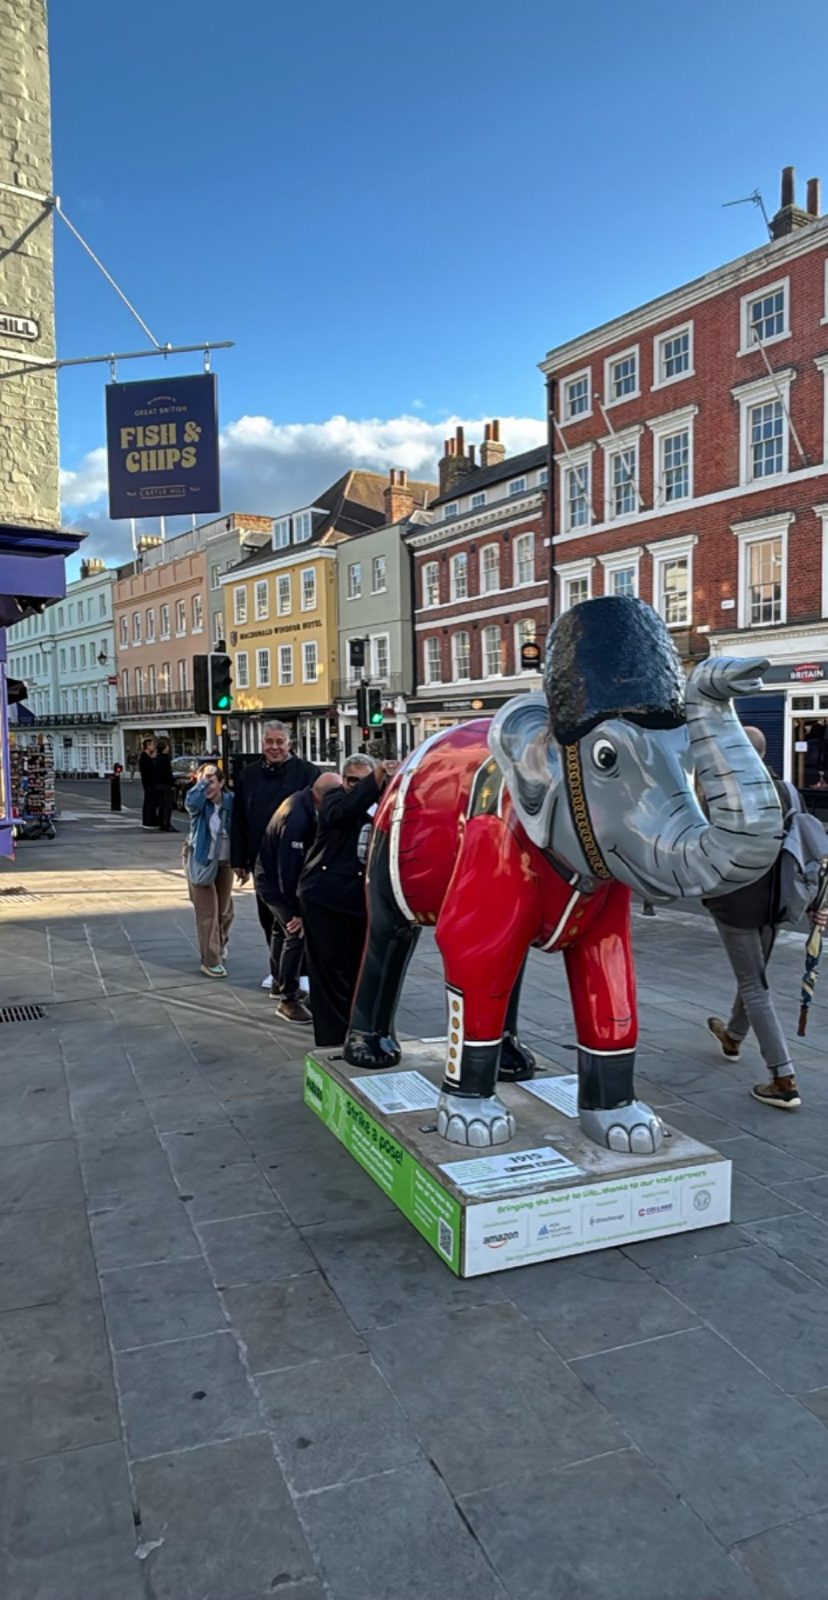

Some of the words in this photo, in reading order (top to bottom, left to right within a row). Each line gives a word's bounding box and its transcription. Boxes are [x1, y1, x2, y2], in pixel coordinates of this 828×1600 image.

[0, 317, 35, 337] HILL
[134, 408, 157, 416] GREAT
[160, 405, 187, 414] BRITISH
[120, 423, 177, 449] FISH
[184, 421, 202, 443] &
[126, 446, 197, 473] CHIPS
[139, 488, 167, 497] CASTLE
[302, 619, 323, 630] HOTEL
[790, 669, 824, 680] BRITAIN
[346, 1100, 371, 1135] Strike
[379, 1136, 404, 1167] pose!
[483, 1230, 519, 1245] amazon
